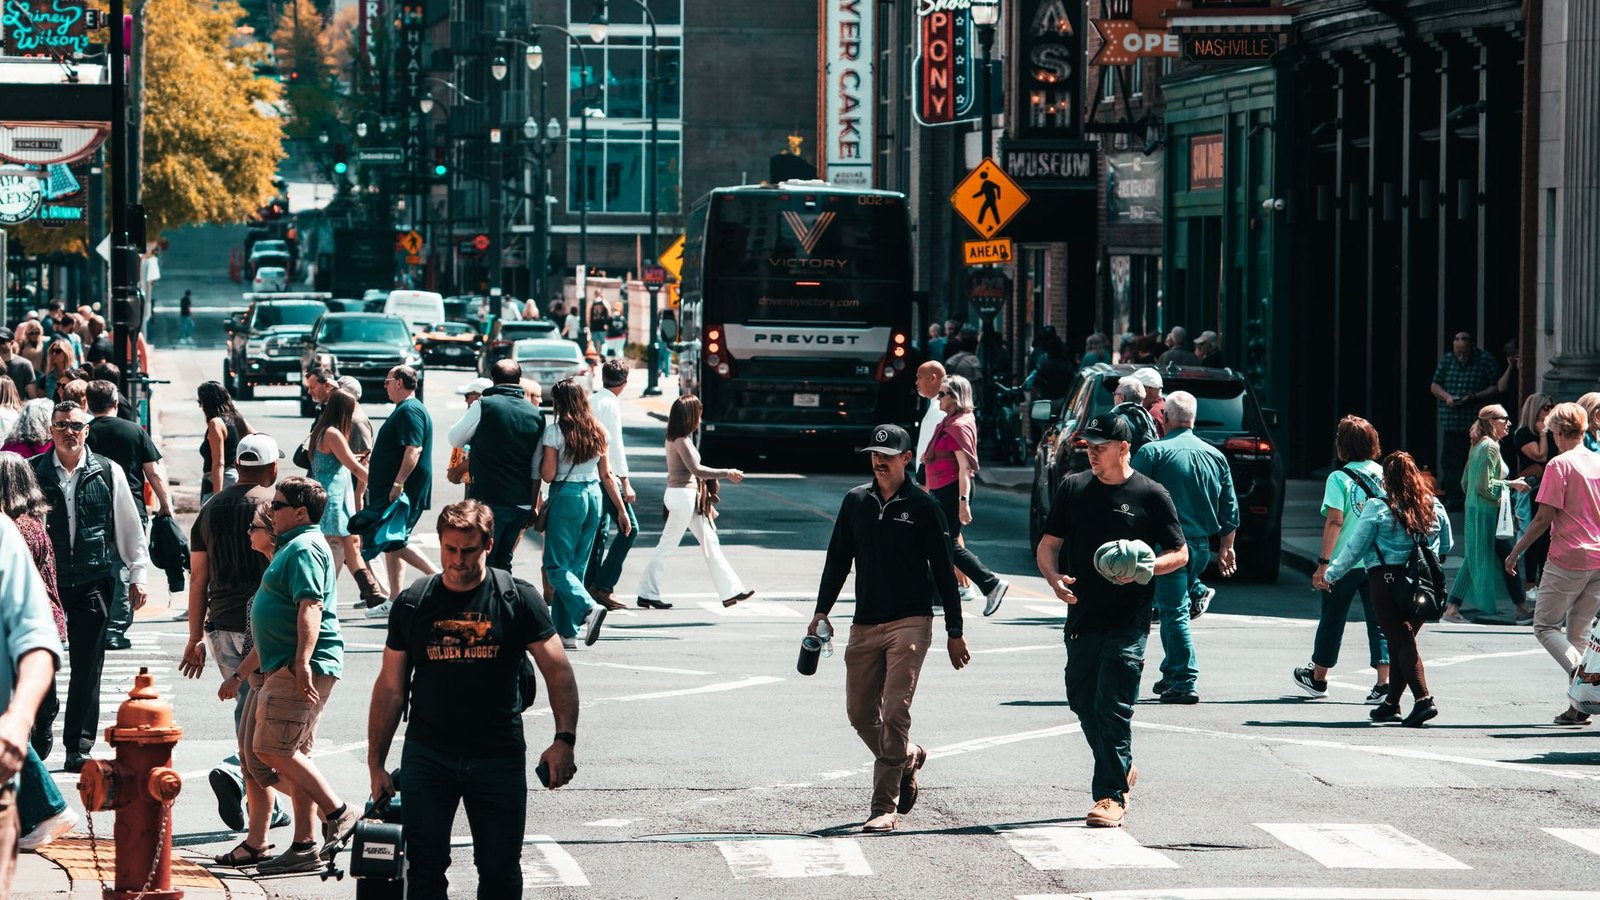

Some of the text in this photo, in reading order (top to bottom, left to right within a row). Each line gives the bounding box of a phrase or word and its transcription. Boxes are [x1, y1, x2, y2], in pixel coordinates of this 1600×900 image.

[1194, 38, 1269, 56] NASHVILLE
[407, 30, 419, 97] HYATT
[930, 12, 947, 115] PONY
[839, 68, 861, 159] CAKE
[18, 141, 40, 149] SINCE
[1008, 152, 1091, 178] MUSEUM
[858, 195, 882, 205] 002
[970, 244, 1009, 259] AHEAD
[768, 258, 848, 268] VICTORY
[754, 333, 860, 345] PREVOST
[426, 645, 500, 661] GOLDEN NUGGET
